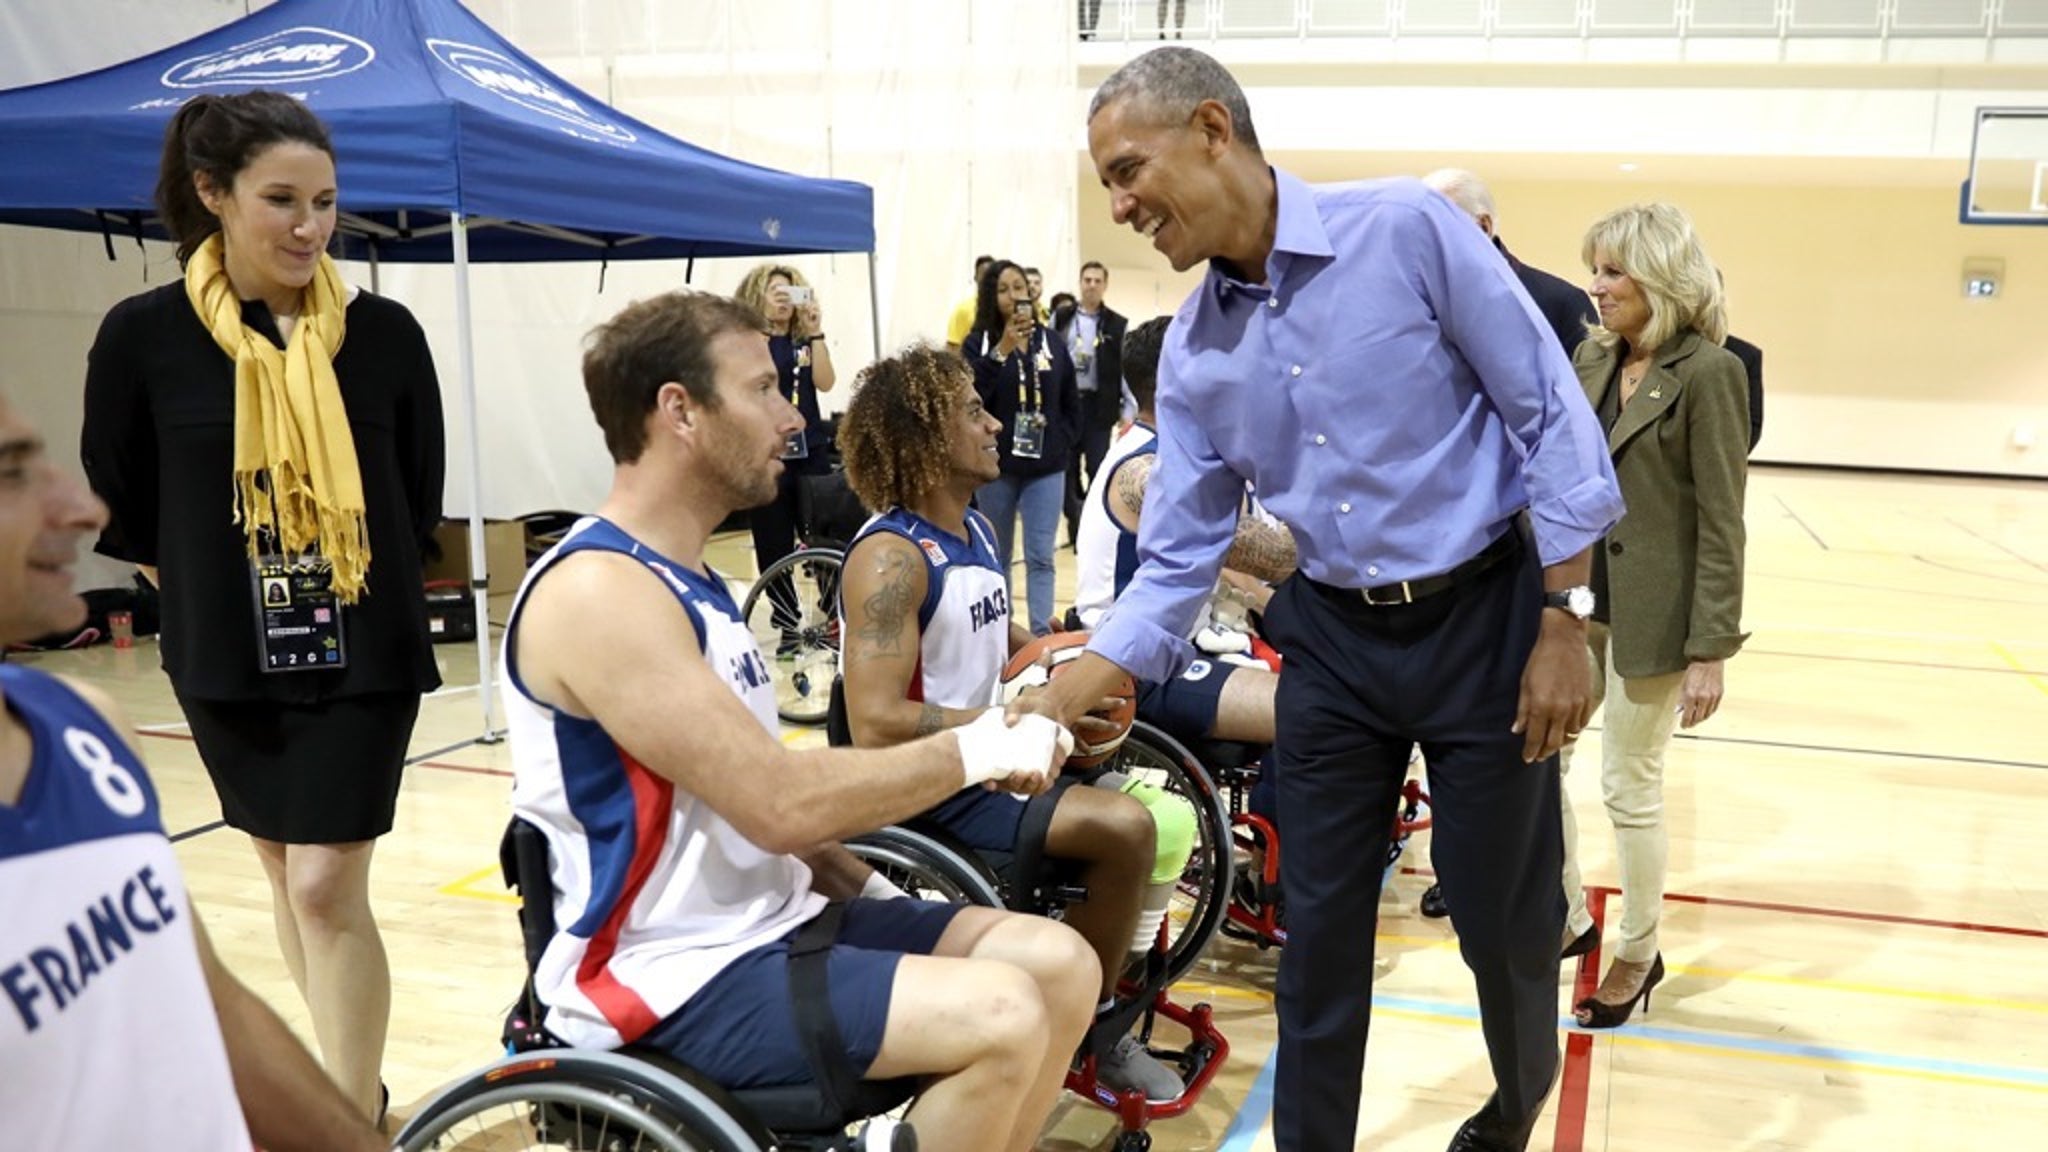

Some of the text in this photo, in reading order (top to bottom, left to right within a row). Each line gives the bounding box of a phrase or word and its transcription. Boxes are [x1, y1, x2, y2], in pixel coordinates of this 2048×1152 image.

[270, 655, 277, 665] 1
[289, 653, 297, 664] 2
[64, 726, 145, 817] 8
[0, 865, 176, 1033] FRANCE
